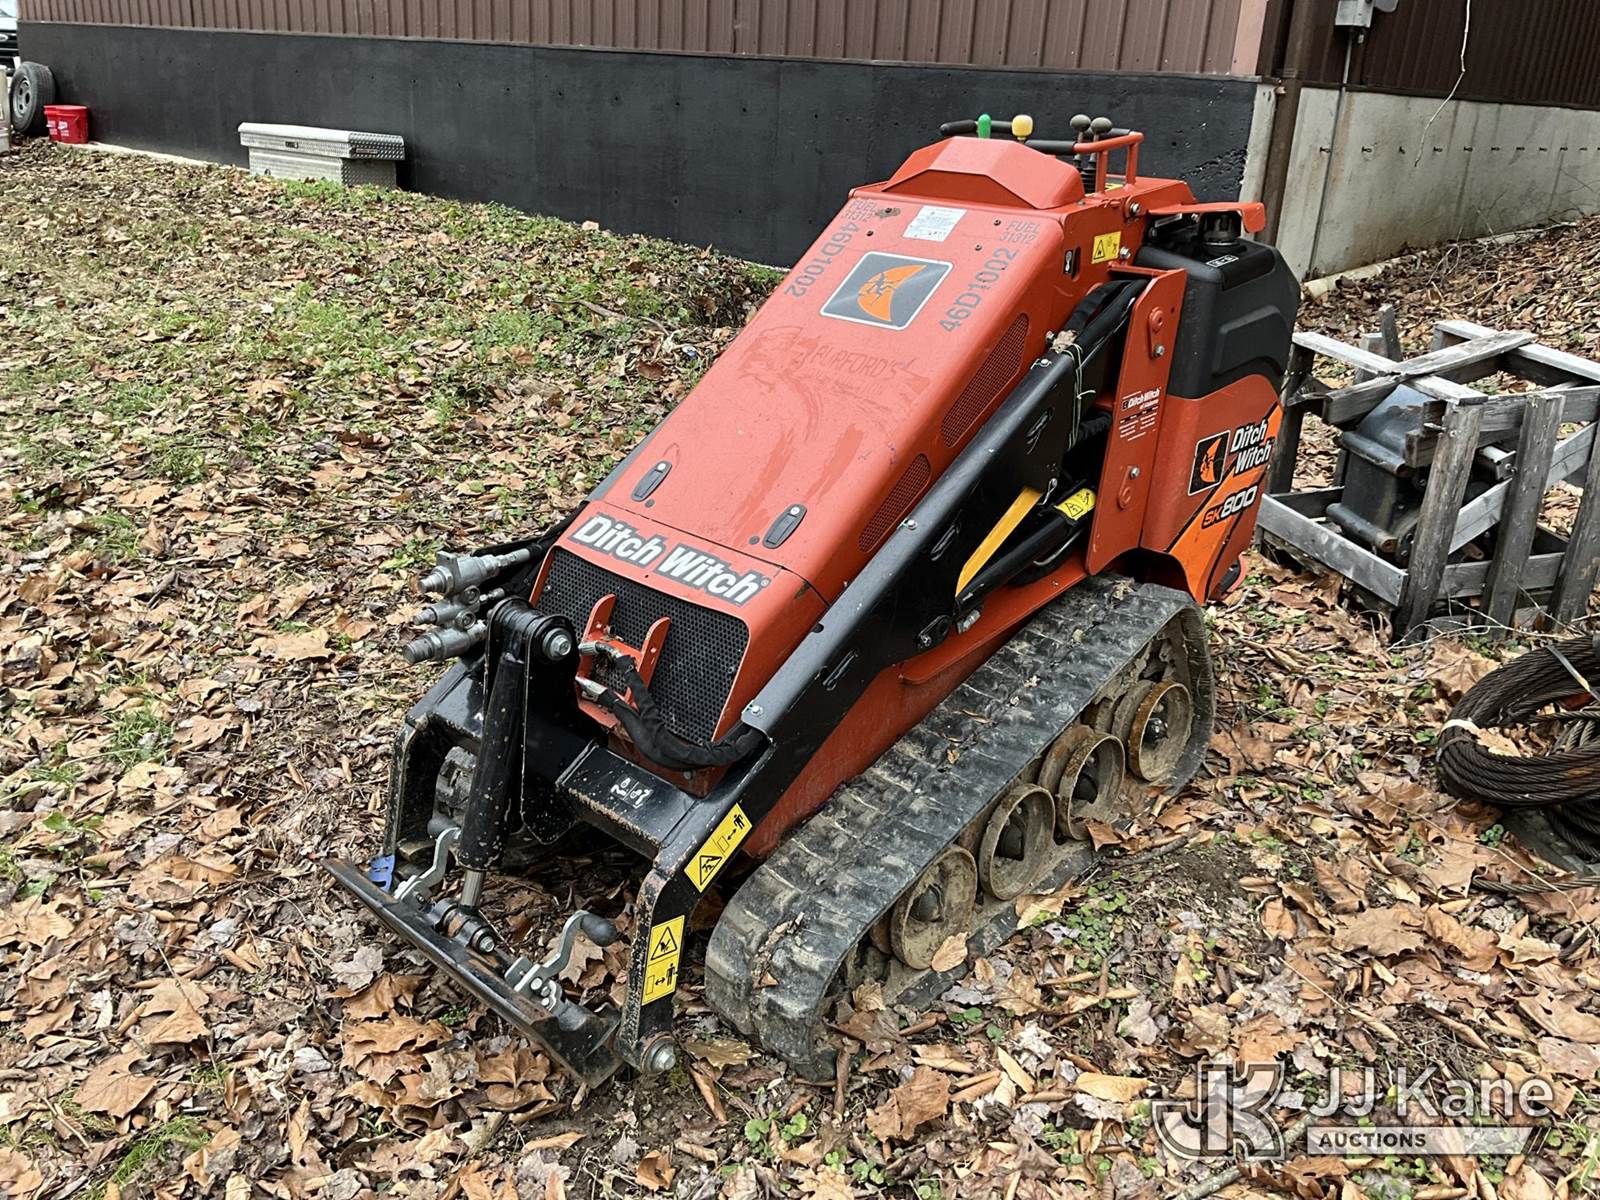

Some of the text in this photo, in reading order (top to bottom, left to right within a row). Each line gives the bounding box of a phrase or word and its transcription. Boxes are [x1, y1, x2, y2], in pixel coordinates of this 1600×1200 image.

[1006, 220, 1041, 235] FUEL
[783, 221, 860, 298] 46D1002
[938, 247, 1019, 332] 46D1002
[1229, 418, 1269, 454] Ditch
[1234, 438, 1273, 475] Witch
[1202, 484, 1259, 526] SK800
[570, 513, 665, 567] Ditch
